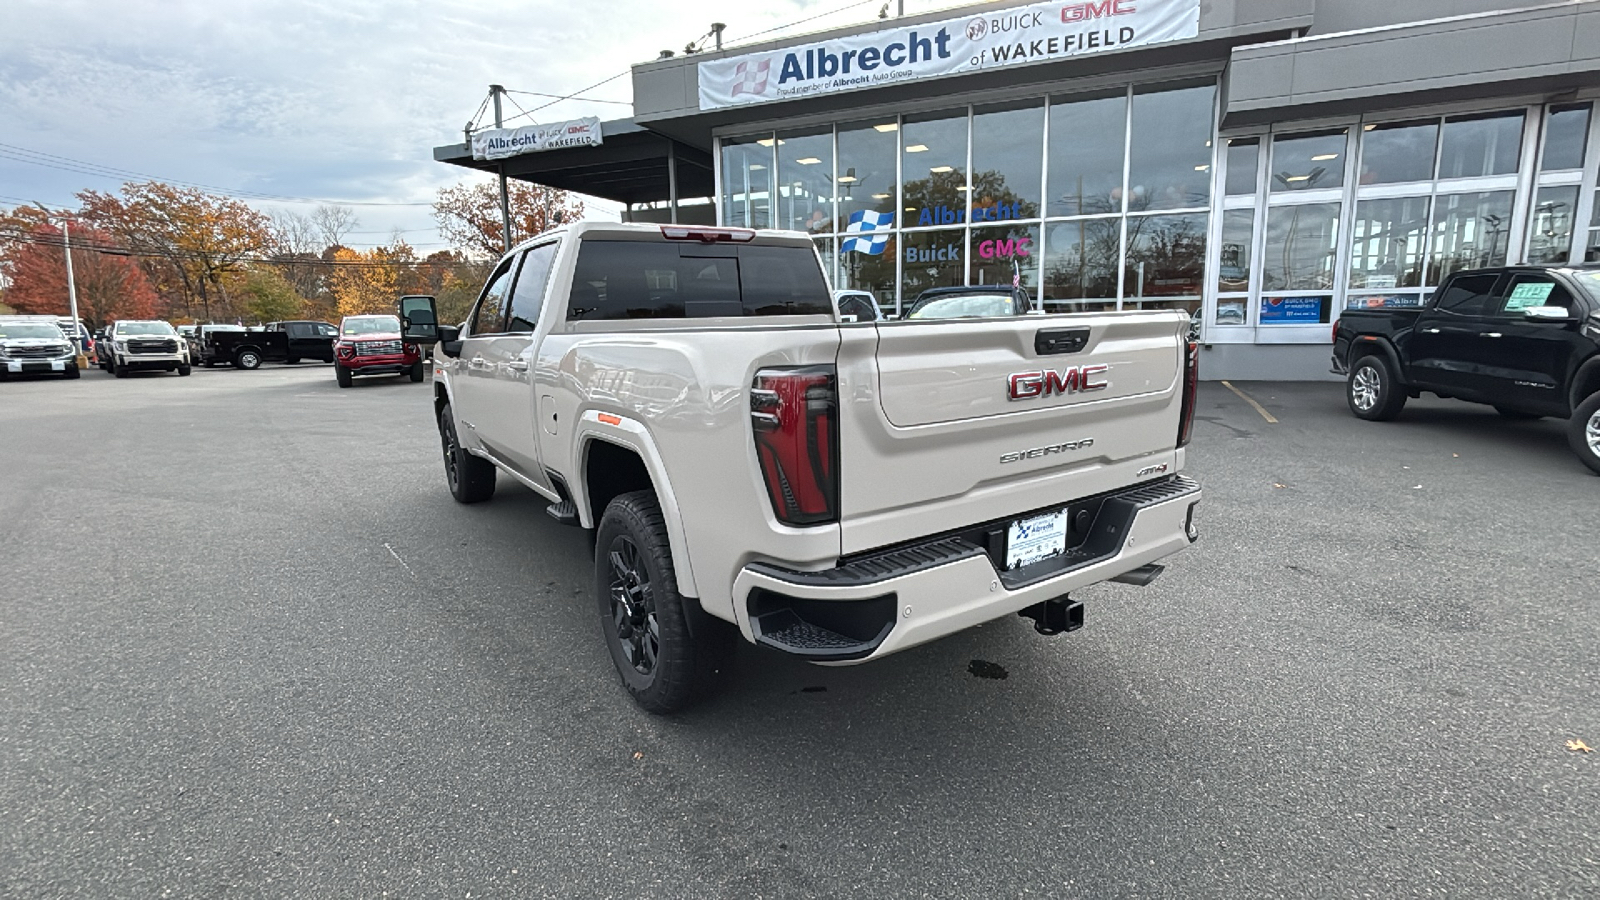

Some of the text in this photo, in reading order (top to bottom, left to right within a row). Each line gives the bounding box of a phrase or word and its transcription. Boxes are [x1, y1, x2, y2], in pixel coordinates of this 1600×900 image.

[991, 0, 1137, 34] BUICK GMC
[778, 26, 951, 85] Albrecht
[970, 26, 1135, 66] of WAKEFIELD
[776, 69, 912, 96] Proud member of Albrecht Auto Group
[488, 132, 537, 150] Albrecht
[547, 136, 592, 148] WAKEFIELD
[567, 124, 590, 134] GMC
[918, 201, 1021, 226] Albrecht
[906, 237, 1032, 263] Buick GMC
[1007, 363, 1109, 402] GMC
[999, 438, 1094, 464] SIERRA
